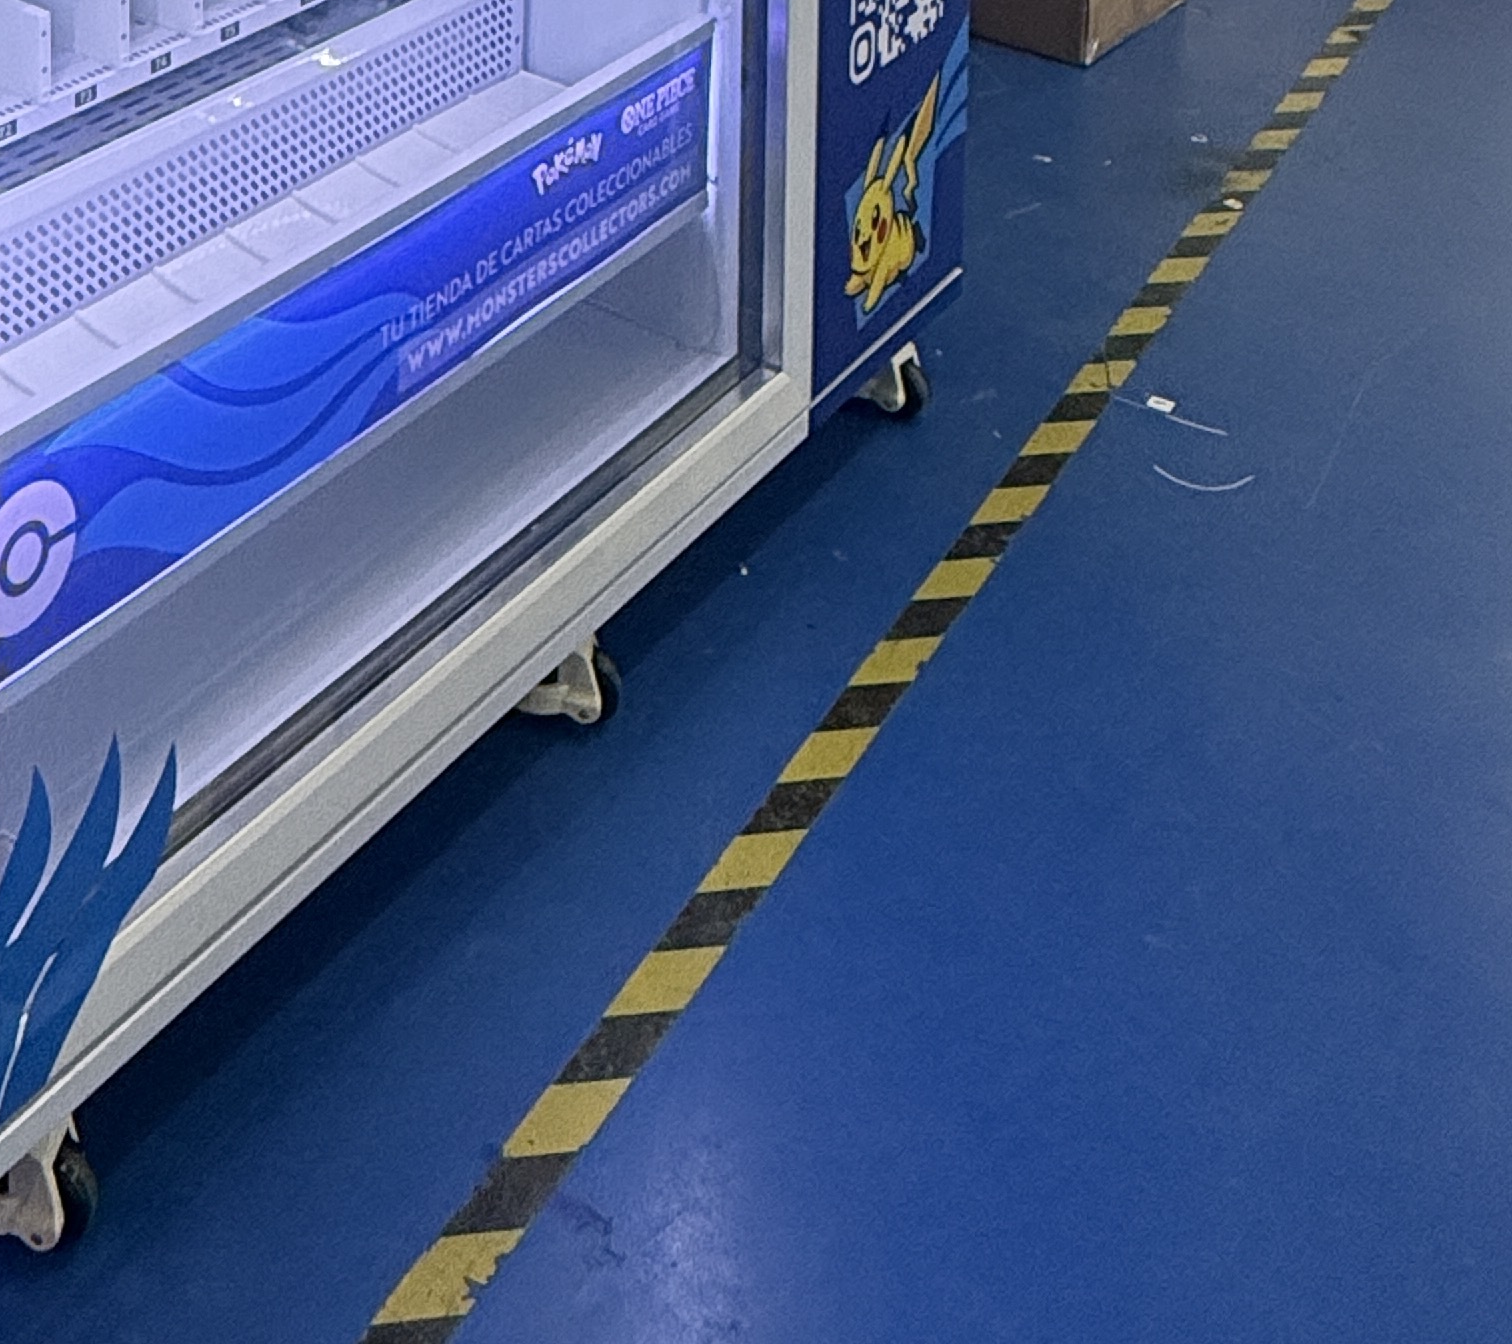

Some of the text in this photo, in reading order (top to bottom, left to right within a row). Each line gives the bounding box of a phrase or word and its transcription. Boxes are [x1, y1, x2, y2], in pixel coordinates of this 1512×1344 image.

[620, 66, 696, 135] ONE PIECE
[380, 121, 693, 349] TU TIENDA DE CARTAS COLECCIONABLES
[406, 164, 692, 374] WWW.MONSTERSCOLLECTORS.COM
